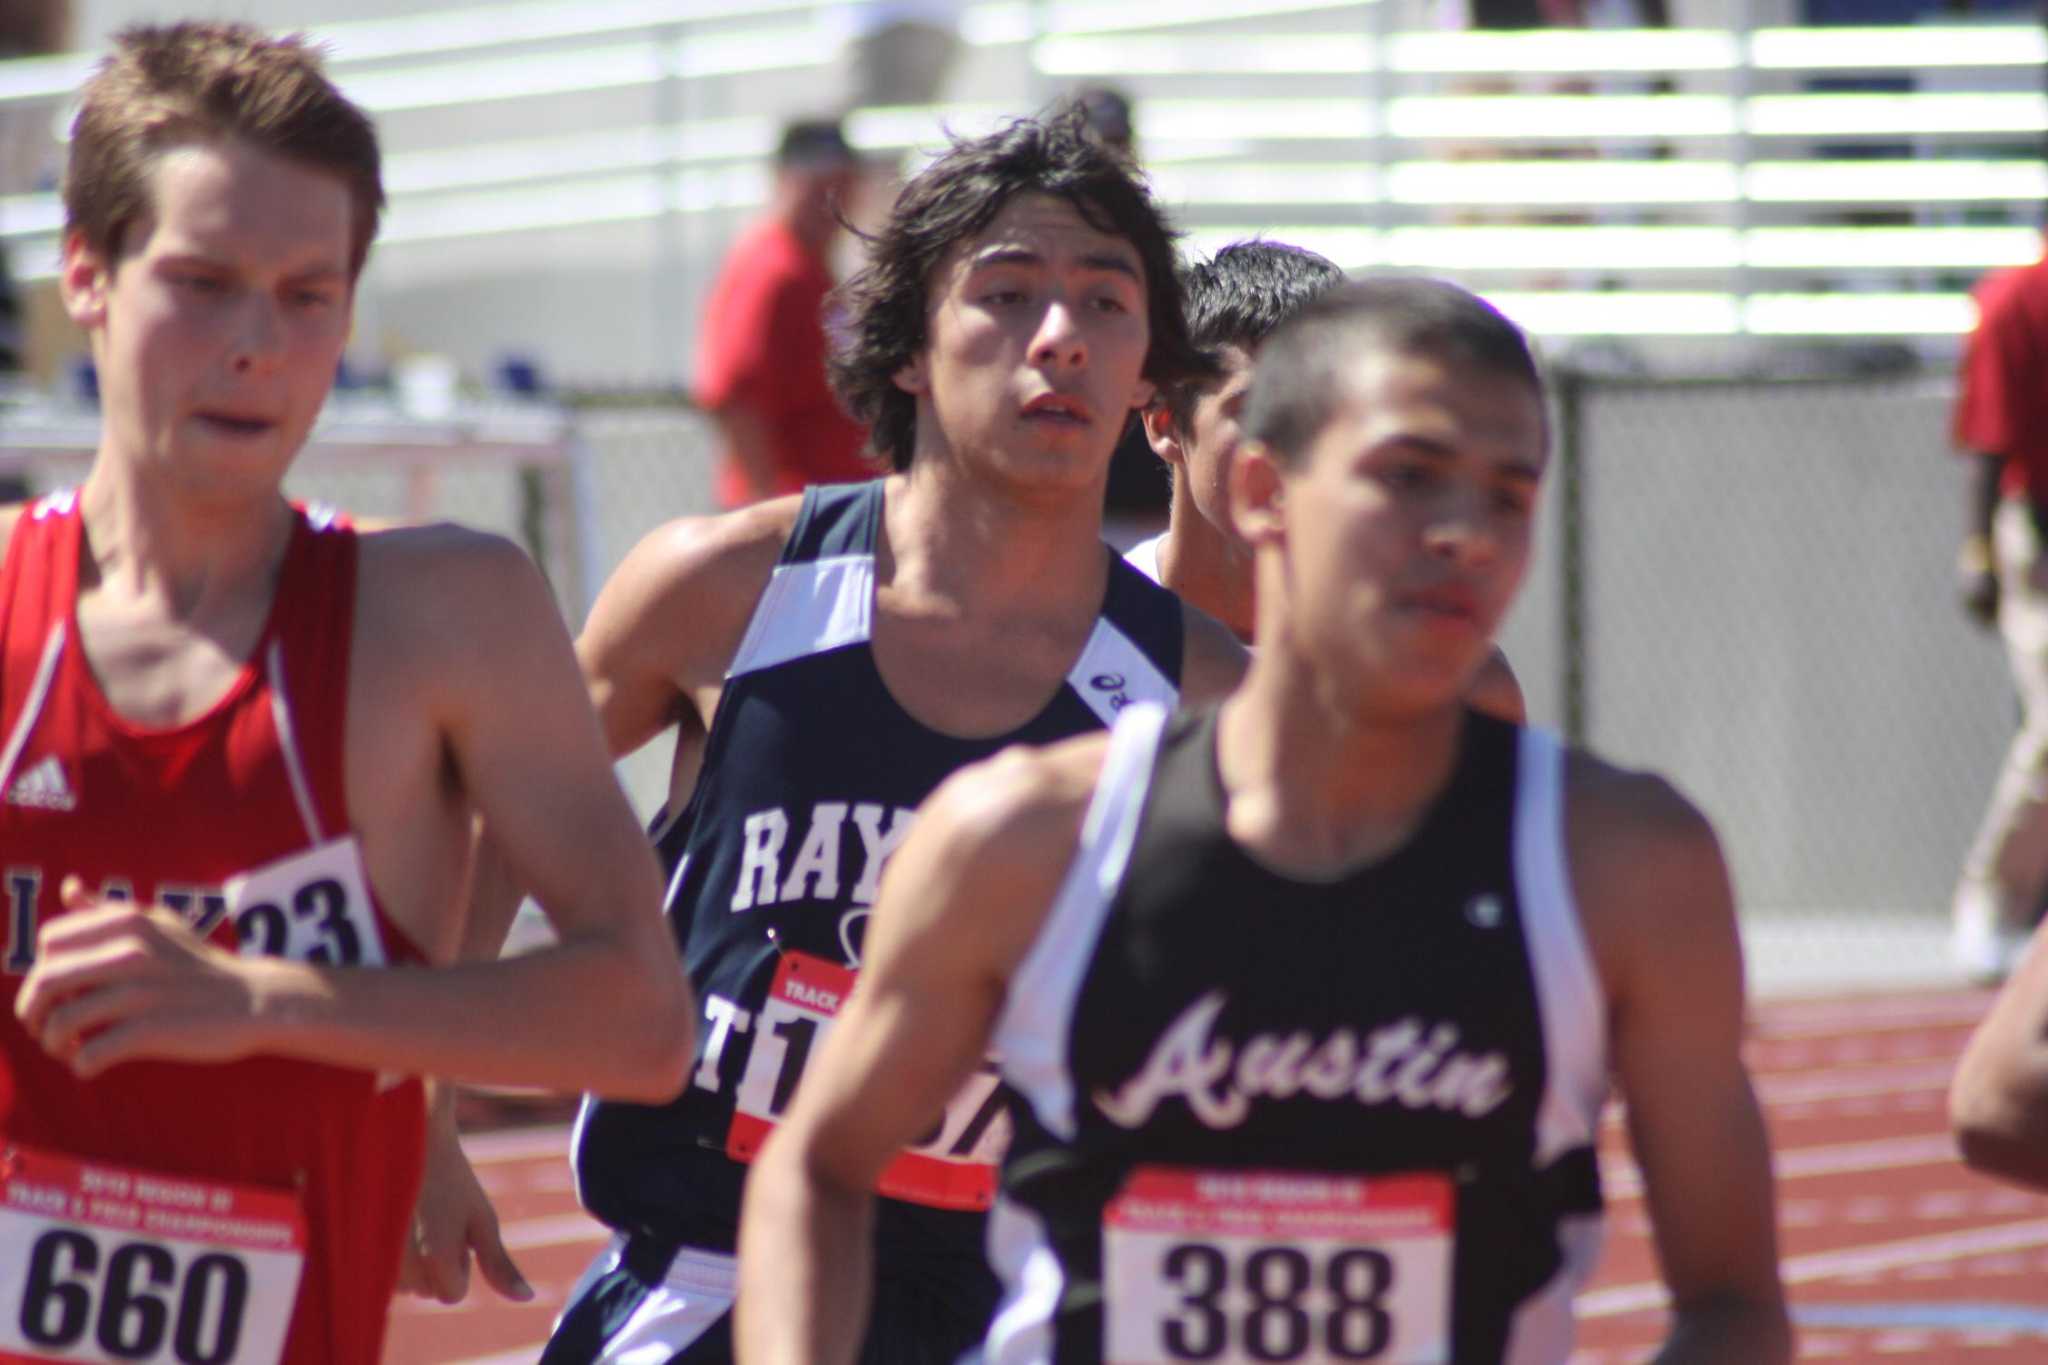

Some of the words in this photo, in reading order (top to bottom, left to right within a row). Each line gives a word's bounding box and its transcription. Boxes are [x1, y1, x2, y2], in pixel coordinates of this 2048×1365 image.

[784, 978, 839, 1010] TRACK
[1093, 987, 1513, 1130] Austin
[20, 1230, 248, 1365] 660
[1161, 1243, 1392, 1362] 388
